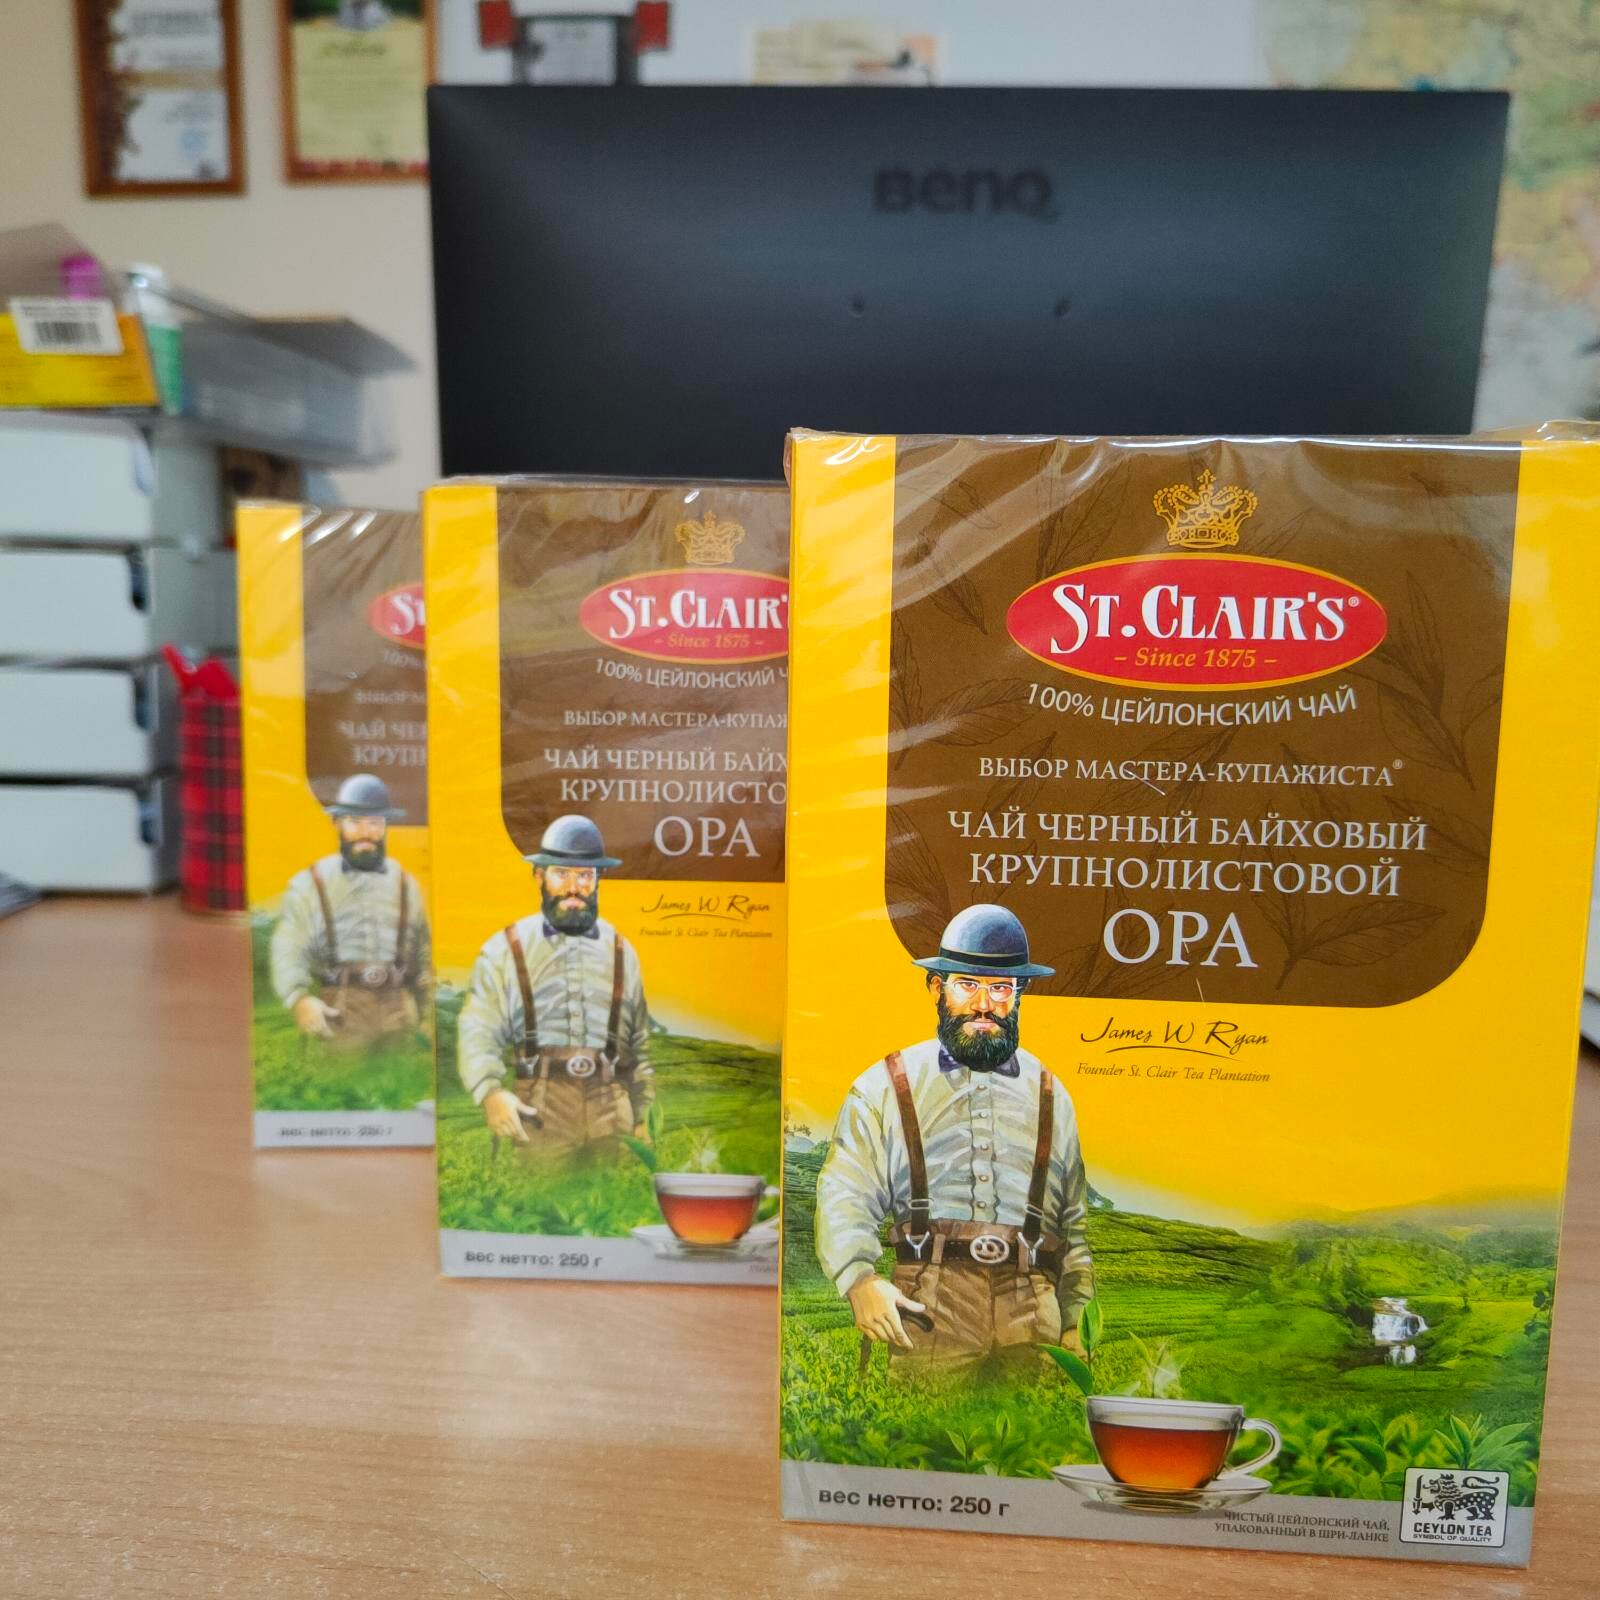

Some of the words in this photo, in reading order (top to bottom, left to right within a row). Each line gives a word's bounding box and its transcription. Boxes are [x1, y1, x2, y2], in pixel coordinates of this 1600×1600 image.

[872, 167, 1060, 222] BenQ
[668, 634, 710, 649] Since
[1135, 647, 1196, 668] Since
[1203, 649, 1257, 669] 1875
[596, 658, 642, 683] 100%
[646, 666, 775, 689] ЦЕЙЛОНСКИЙ
[1028, 683, 1095, 718] 100%
[1101, 695, 1292, 726] ЦЕЙЛОНСКИЙ
[1299, 683, 1358, 718] ЧАЙ
[564, 711, 627, 727] ВЫБОР
[544, 745, 599, 770] ЧАЙ
[607, 747, 716, 771] ЧЕРНЫЙ
[979, 757, 1068, 779] ВЫБОР
[948, 806, 1026, 840] ЧАЙ
[1037, 809, 1198, 846] ЧЕРНЫЙ
[1208, 813, 1427, 851] БАЙХОВЫЙ
[969, 853, 1399, 896] КРУПНОЛИСТОВОЙ
[1080, 1016, 1153, 1043] James
[1163, 1020, 1195, 1044] W
[1205, 1020, 1269, 1055] Ryan
[1077, 1062, 1125, 1077] Founder
[1127, 1064, 1142, 1077] St.
[1146, 1065, 1178, 1079] Clair
[1184, 1067, 1204, 1080] Tea
[1208, 1067, 1271, 1083] Plantation
[559, 1252, 589, 1267] 250
[868, 1492, 942, 1512] нетто:
[950, 1495, 992, 1515] 250
[1223, 1510, 1275, 1525] ЧИСТЫЙ
[1277, 1513, 1359, 1530] ЦЕЙЛОНСКИЙ
[1413, 1522, 1466, 1536] CEYLON
[1469, 1524, 1493, 1537] TEA
[1215, 1522, 1306, 1538] УПАКОВАННЫЙ
[1318, 1528, 1389, 1543] ШРИ-ЛАНКЕ
[1413, 1533, 1445, 1541] SYMBOL
